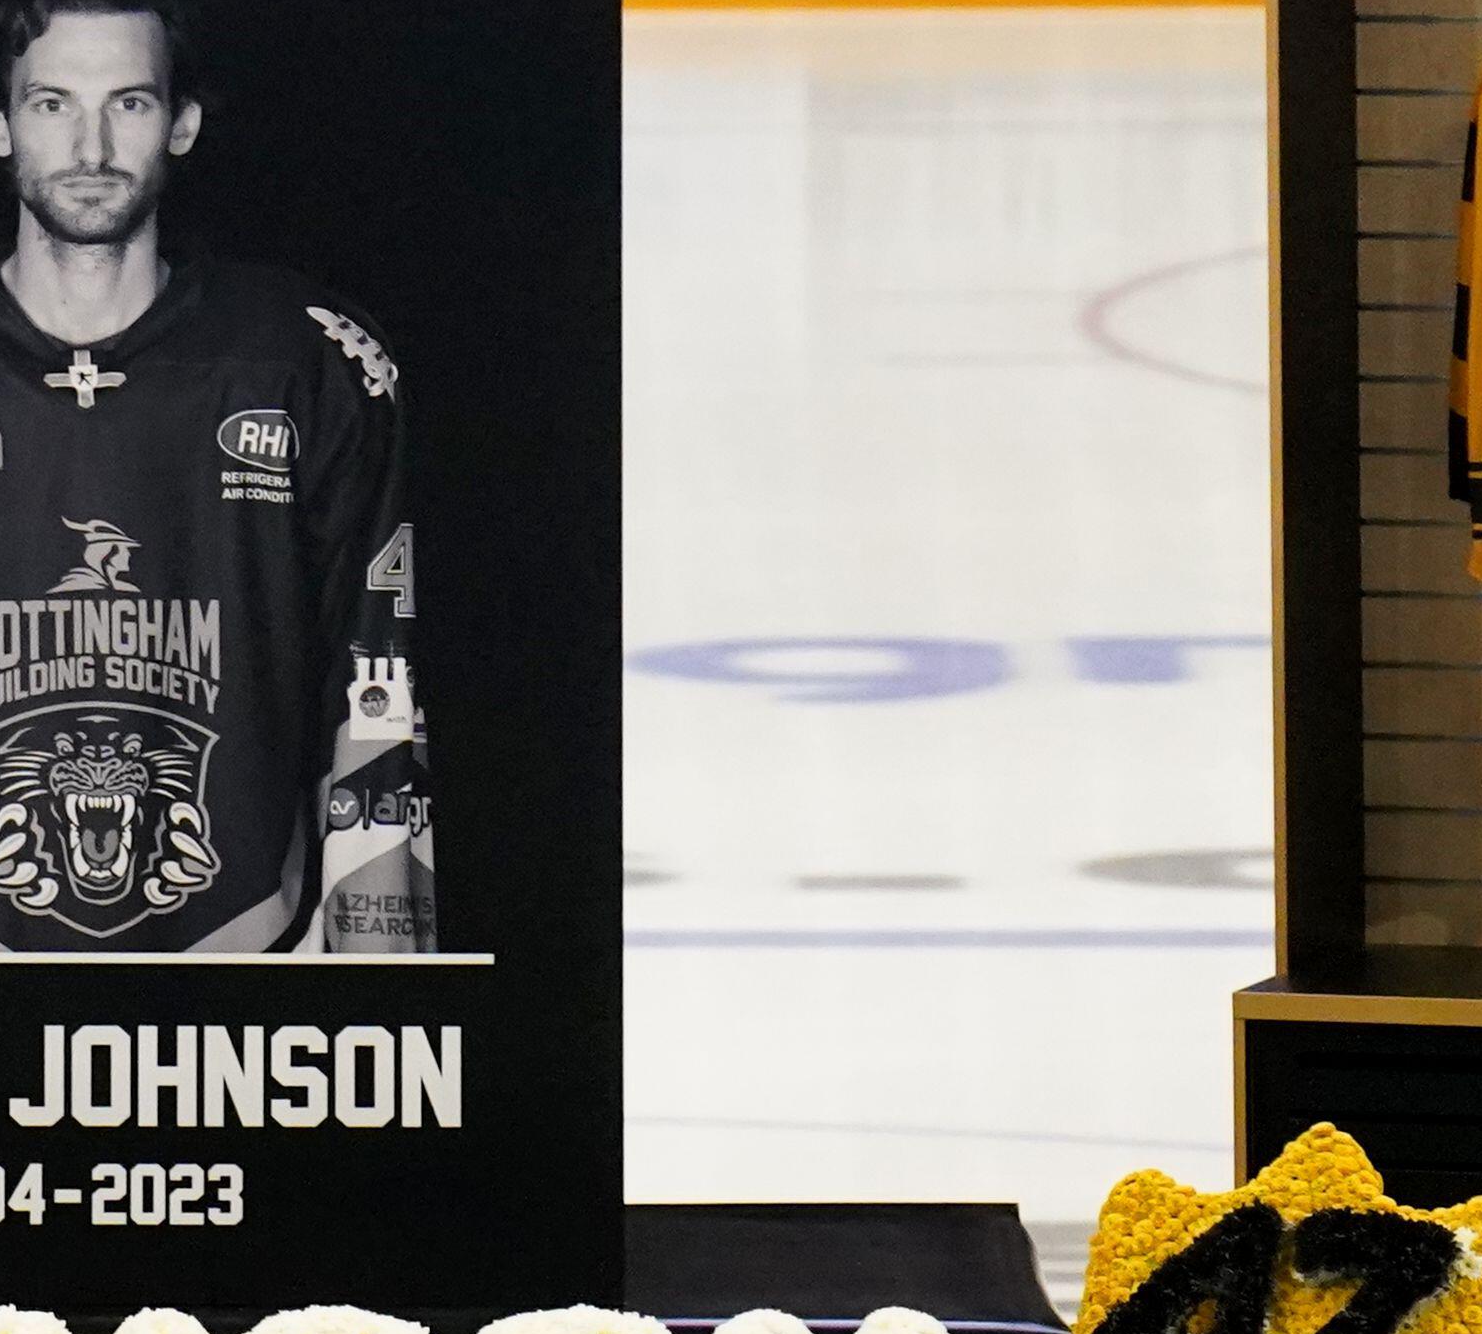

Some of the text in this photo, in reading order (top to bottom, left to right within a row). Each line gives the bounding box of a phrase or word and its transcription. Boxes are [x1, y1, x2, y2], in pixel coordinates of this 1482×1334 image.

[221, 487, 245, 501] AIR
[366, 523, 417, 618] 4
[104, 656, 220, 714] SOCIETY
[8, 1022, 463, 1129] JOHNSON
